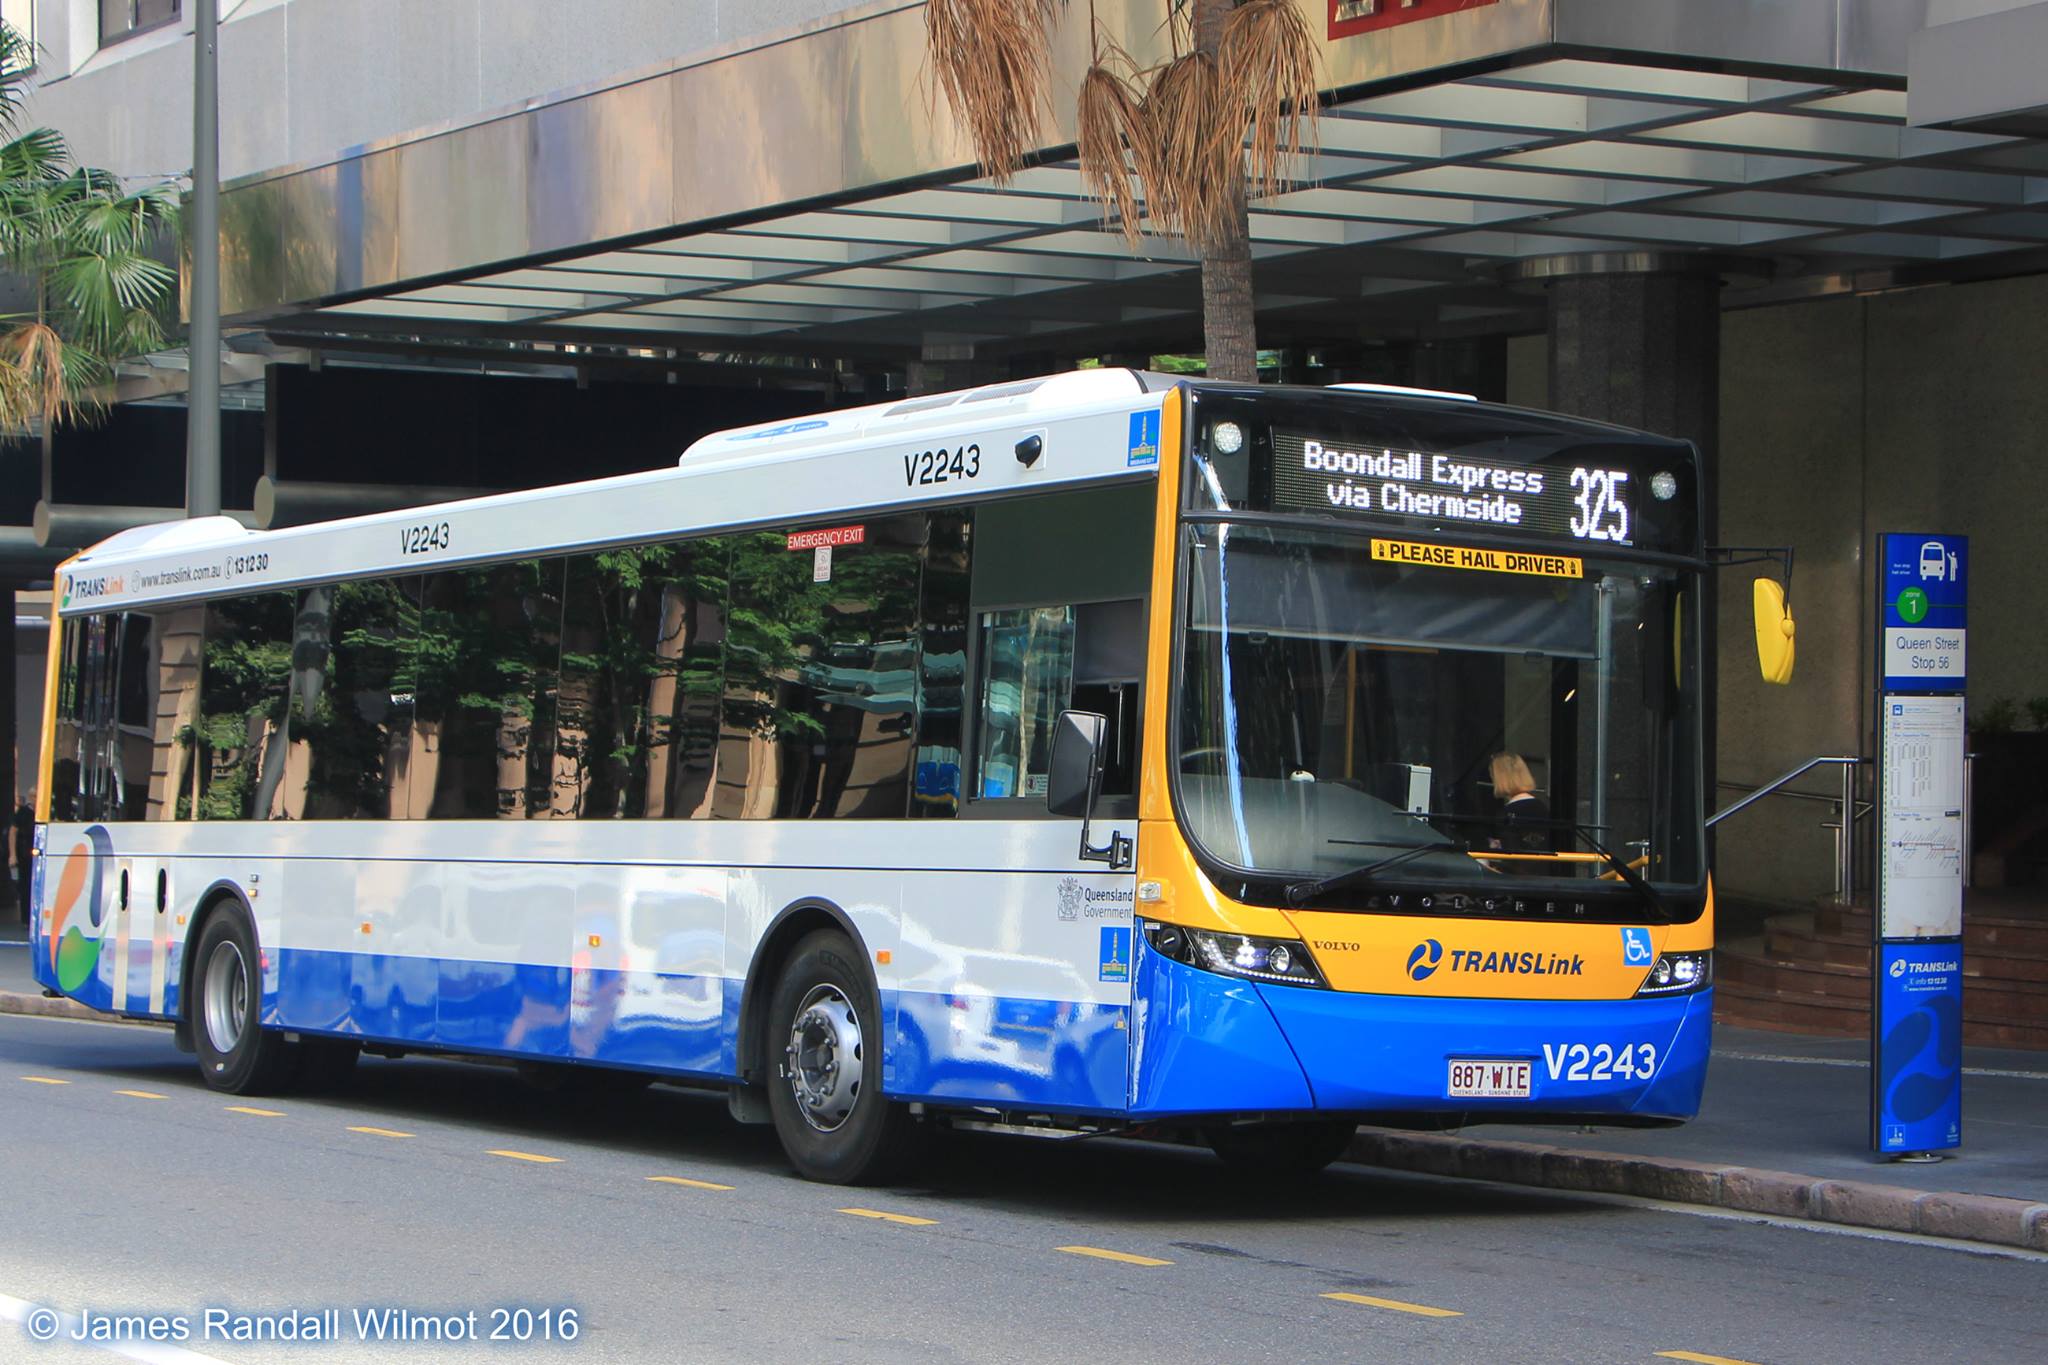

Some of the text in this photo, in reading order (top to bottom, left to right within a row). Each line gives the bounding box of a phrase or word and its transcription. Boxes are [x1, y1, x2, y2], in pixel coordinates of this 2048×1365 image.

[903, 443, 981, 487] V2243
[1303, 440, 1543, 494] Boondall Express
[1326, 481, 1523, 524] via Chermside
[1569, 467, 1629, 541] 325
[400, 521, 450, 556] V2243
[787, 527, 864, 549] EMERGENCY EXIT
[1389, 543, 1566, 575] PLEASE HAIL DRIVER
[75, 574, 125, 599] TRANSLink
[140, 562, 221, 588] www.translink.com.au
[1910, 600, 1916, 615] 1
[1896, 636, 1960, 650] Queen Street
[1911, 655, 1950, 671] Stop 56
[1085, 888, 1133, 902] Queensland
[1084, 905, 1132, 919] Government
[1312, 940, 1360, 952] VOLVO
[1450, 949, 1585, 976] TRANSLink
[1908, 961, 1958, 973] TRANSLink
[1543, 1043, 1656, 1081] V2243
